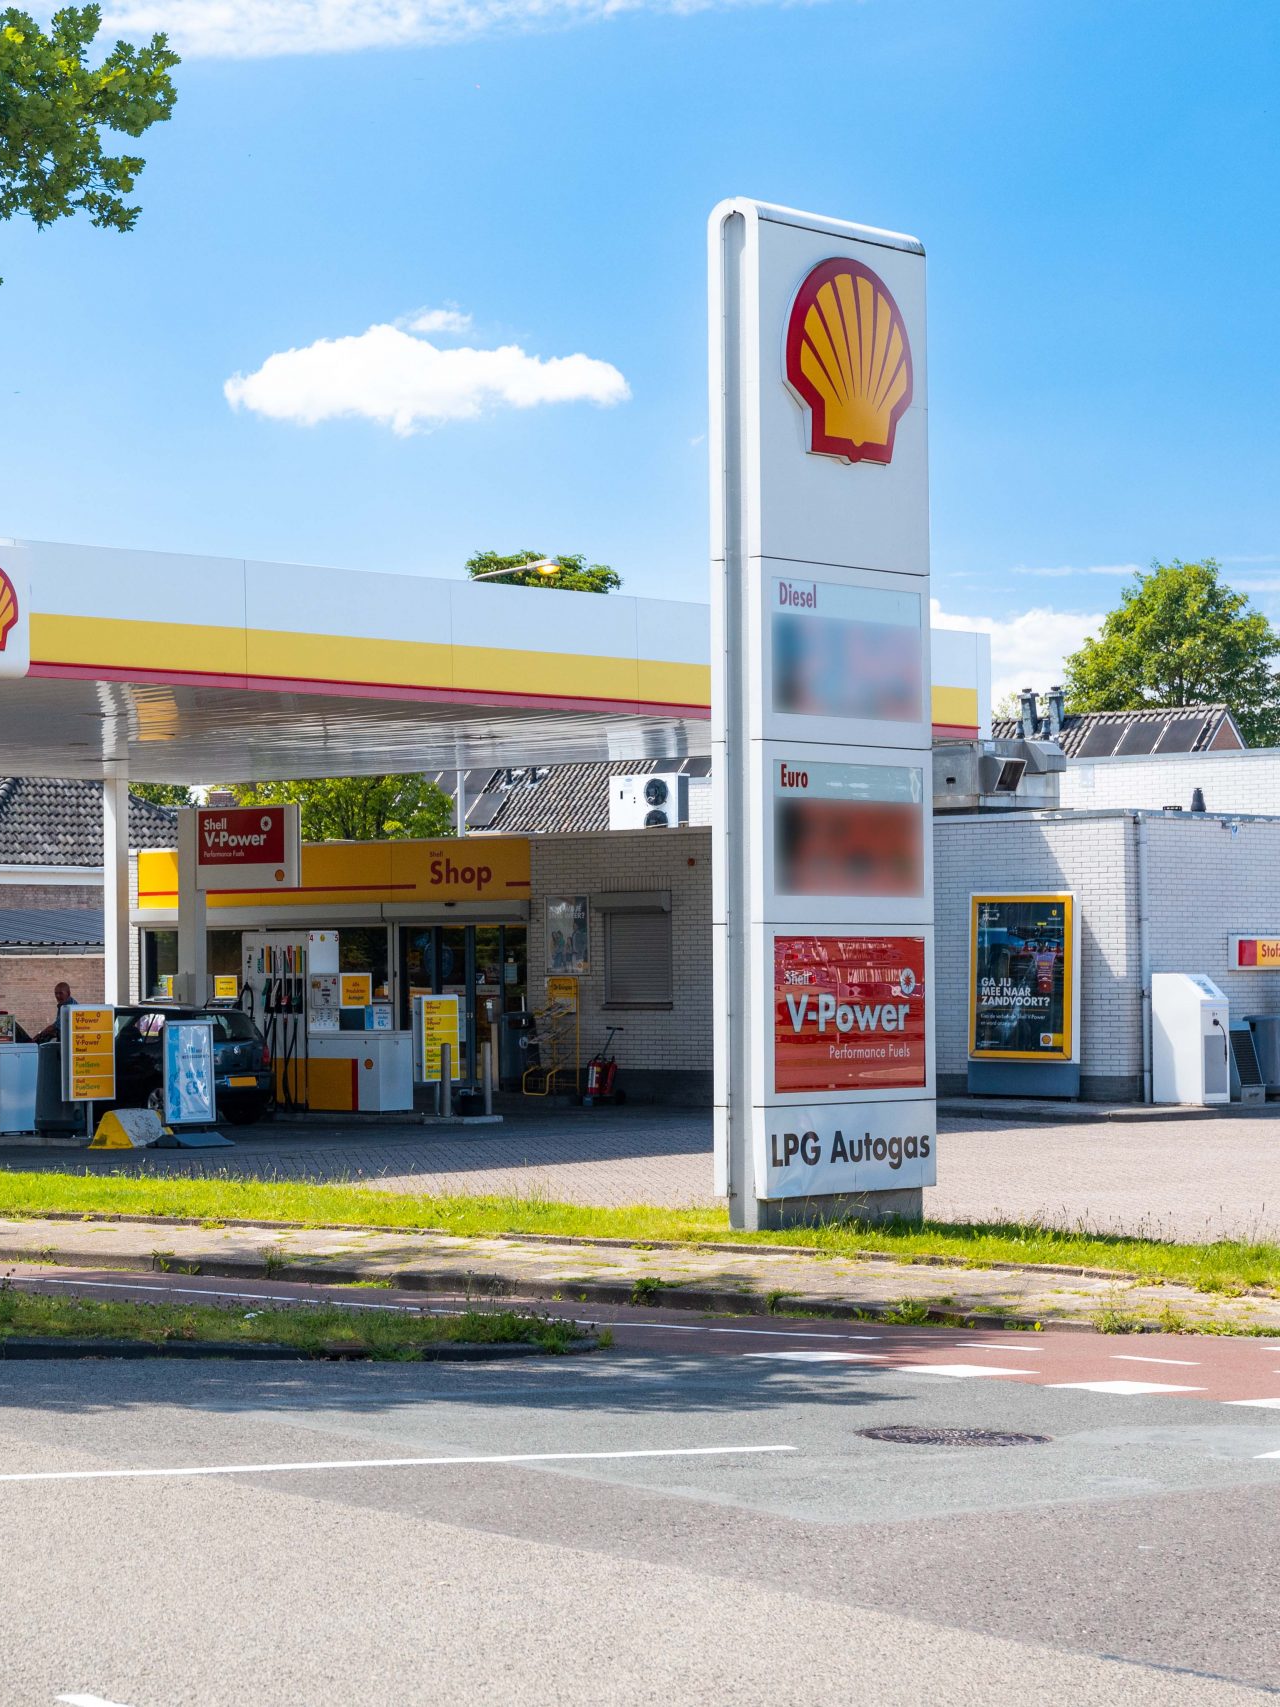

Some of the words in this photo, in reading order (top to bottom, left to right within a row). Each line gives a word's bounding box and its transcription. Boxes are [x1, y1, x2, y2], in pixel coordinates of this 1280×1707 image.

[779, 581, 817, 609] Diesel
[780, 763, 809, 788] Euro
[203, 817, 227, 831] Shell
[204, 831, 267, 848] V-Power
[203, 850, 232, 858] Performance
[232, 849, 245, 857] Fuels
[430, 857, 492, 891] Shop
[309, 934, 314, 942] 4
[334, 934, 339, 942] 5
[981, 977, 996, 987] GA
[998, 977, 1012, 988] JIJ
[981, 986, 1001, 996] MEE
[1003, 987, 1031, 997] NAAR
[981, 996, 1051, 1007] ZANDVOORT?
[785, 993, 910, 1034] V-Power
[829, 1044, 885, 1060] Performance
[888, 1042, 911, 1058] Fuels
[771, 1131, 822, 1168] LPG
[830, 1130, 930, 1170] Autogas
